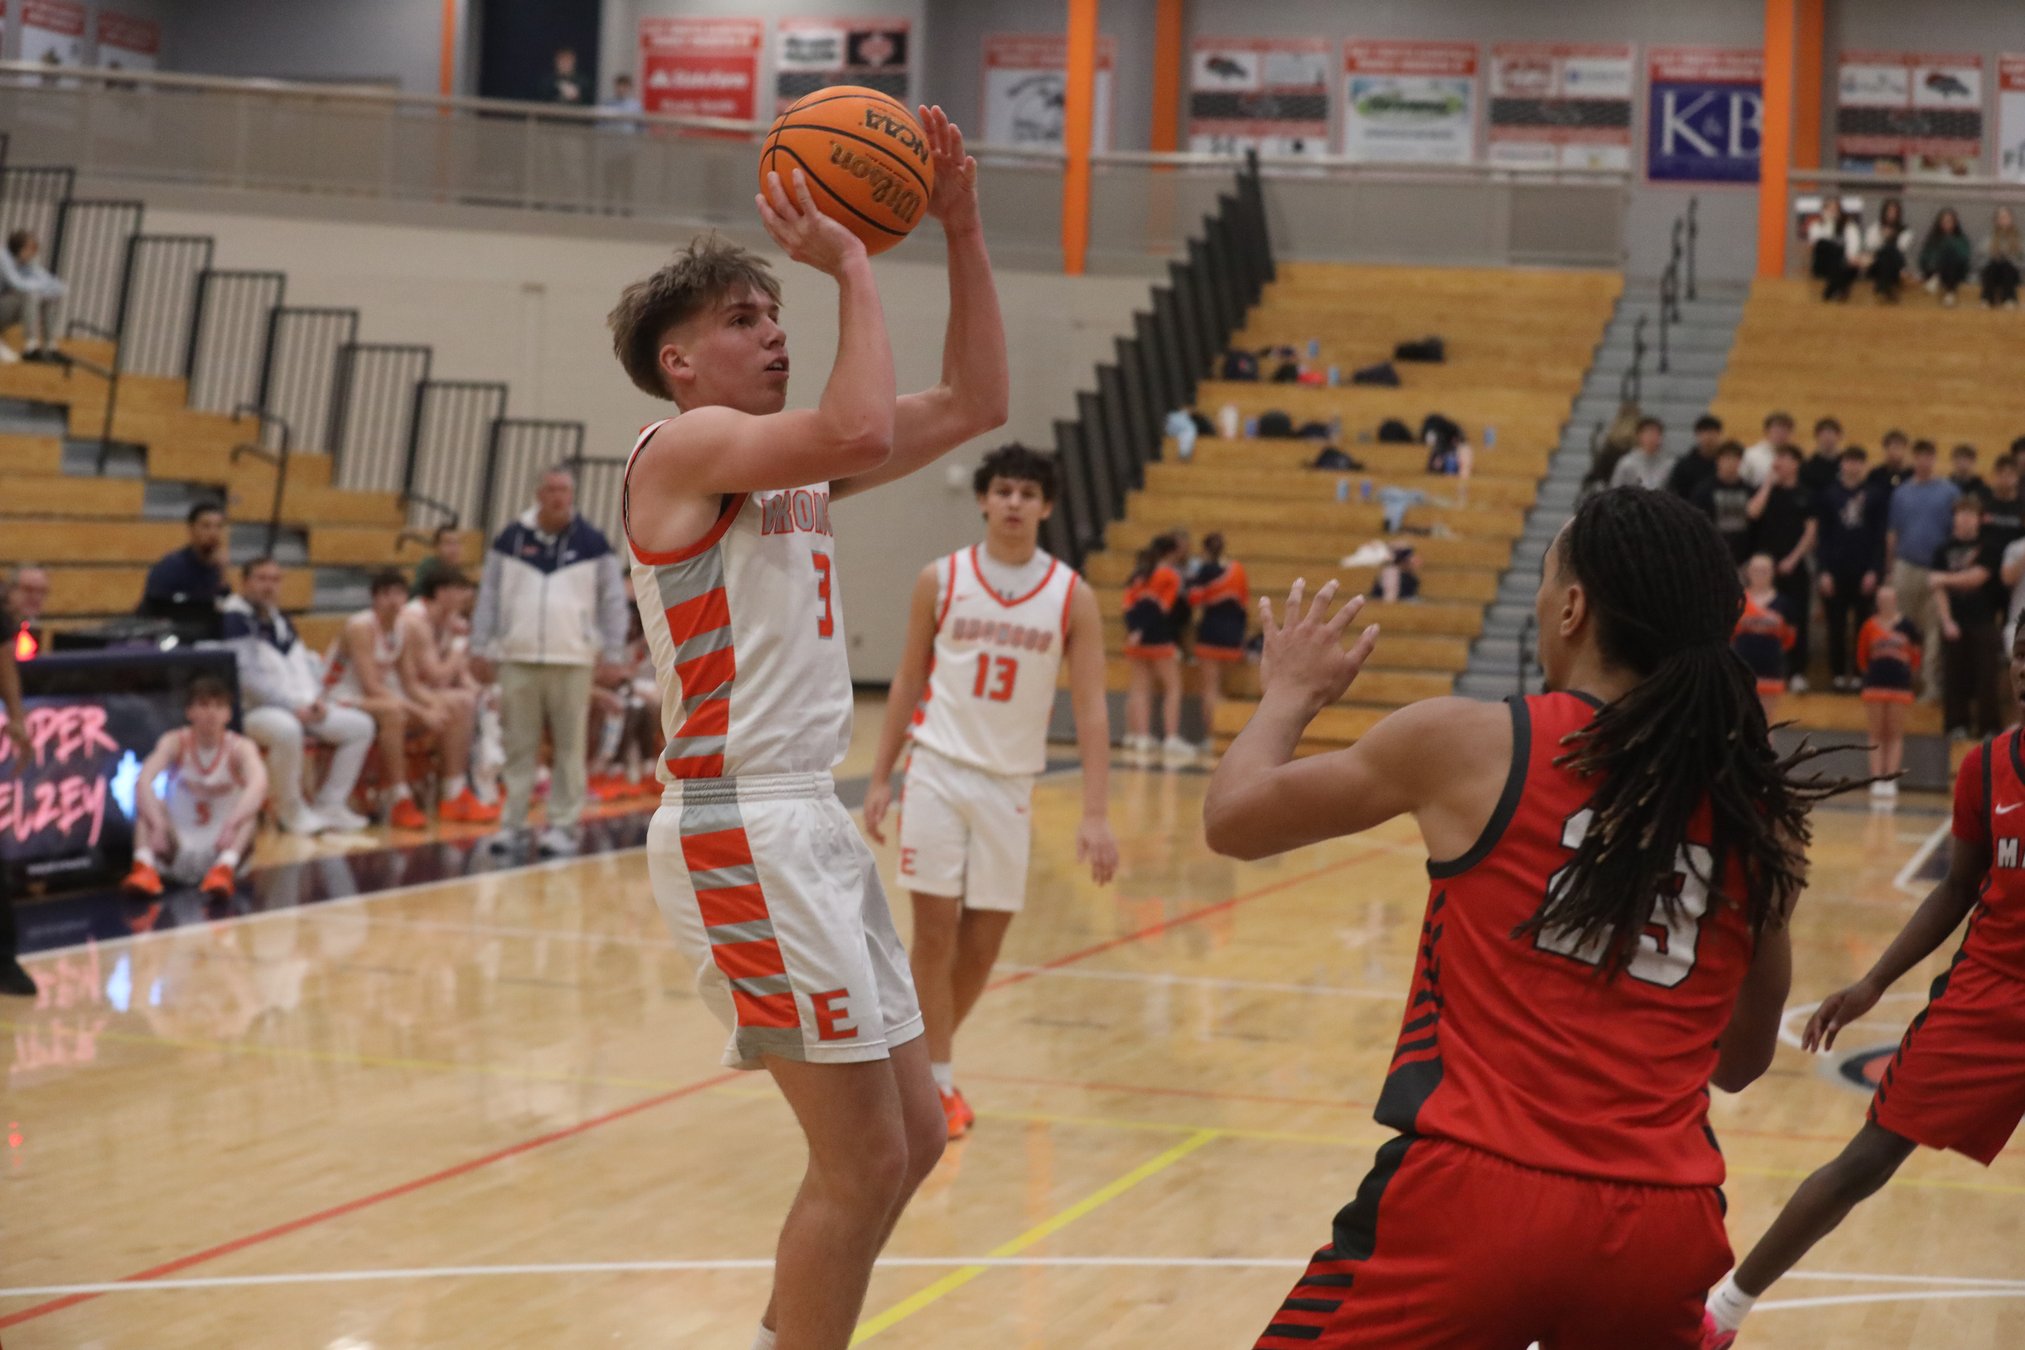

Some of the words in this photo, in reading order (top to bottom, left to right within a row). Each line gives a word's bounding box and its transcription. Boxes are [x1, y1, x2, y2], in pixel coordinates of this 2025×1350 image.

[865, 108, 929, 165] NCAA
[829, 142, 920, 224] Wilson
[811, 549, 834, 640] 3
[973, 653, 1018, 702] 13
[900, 847, 917, 876] E
[1997, 836, 2025, 869] M
[809, 986, 859, 1041] E
